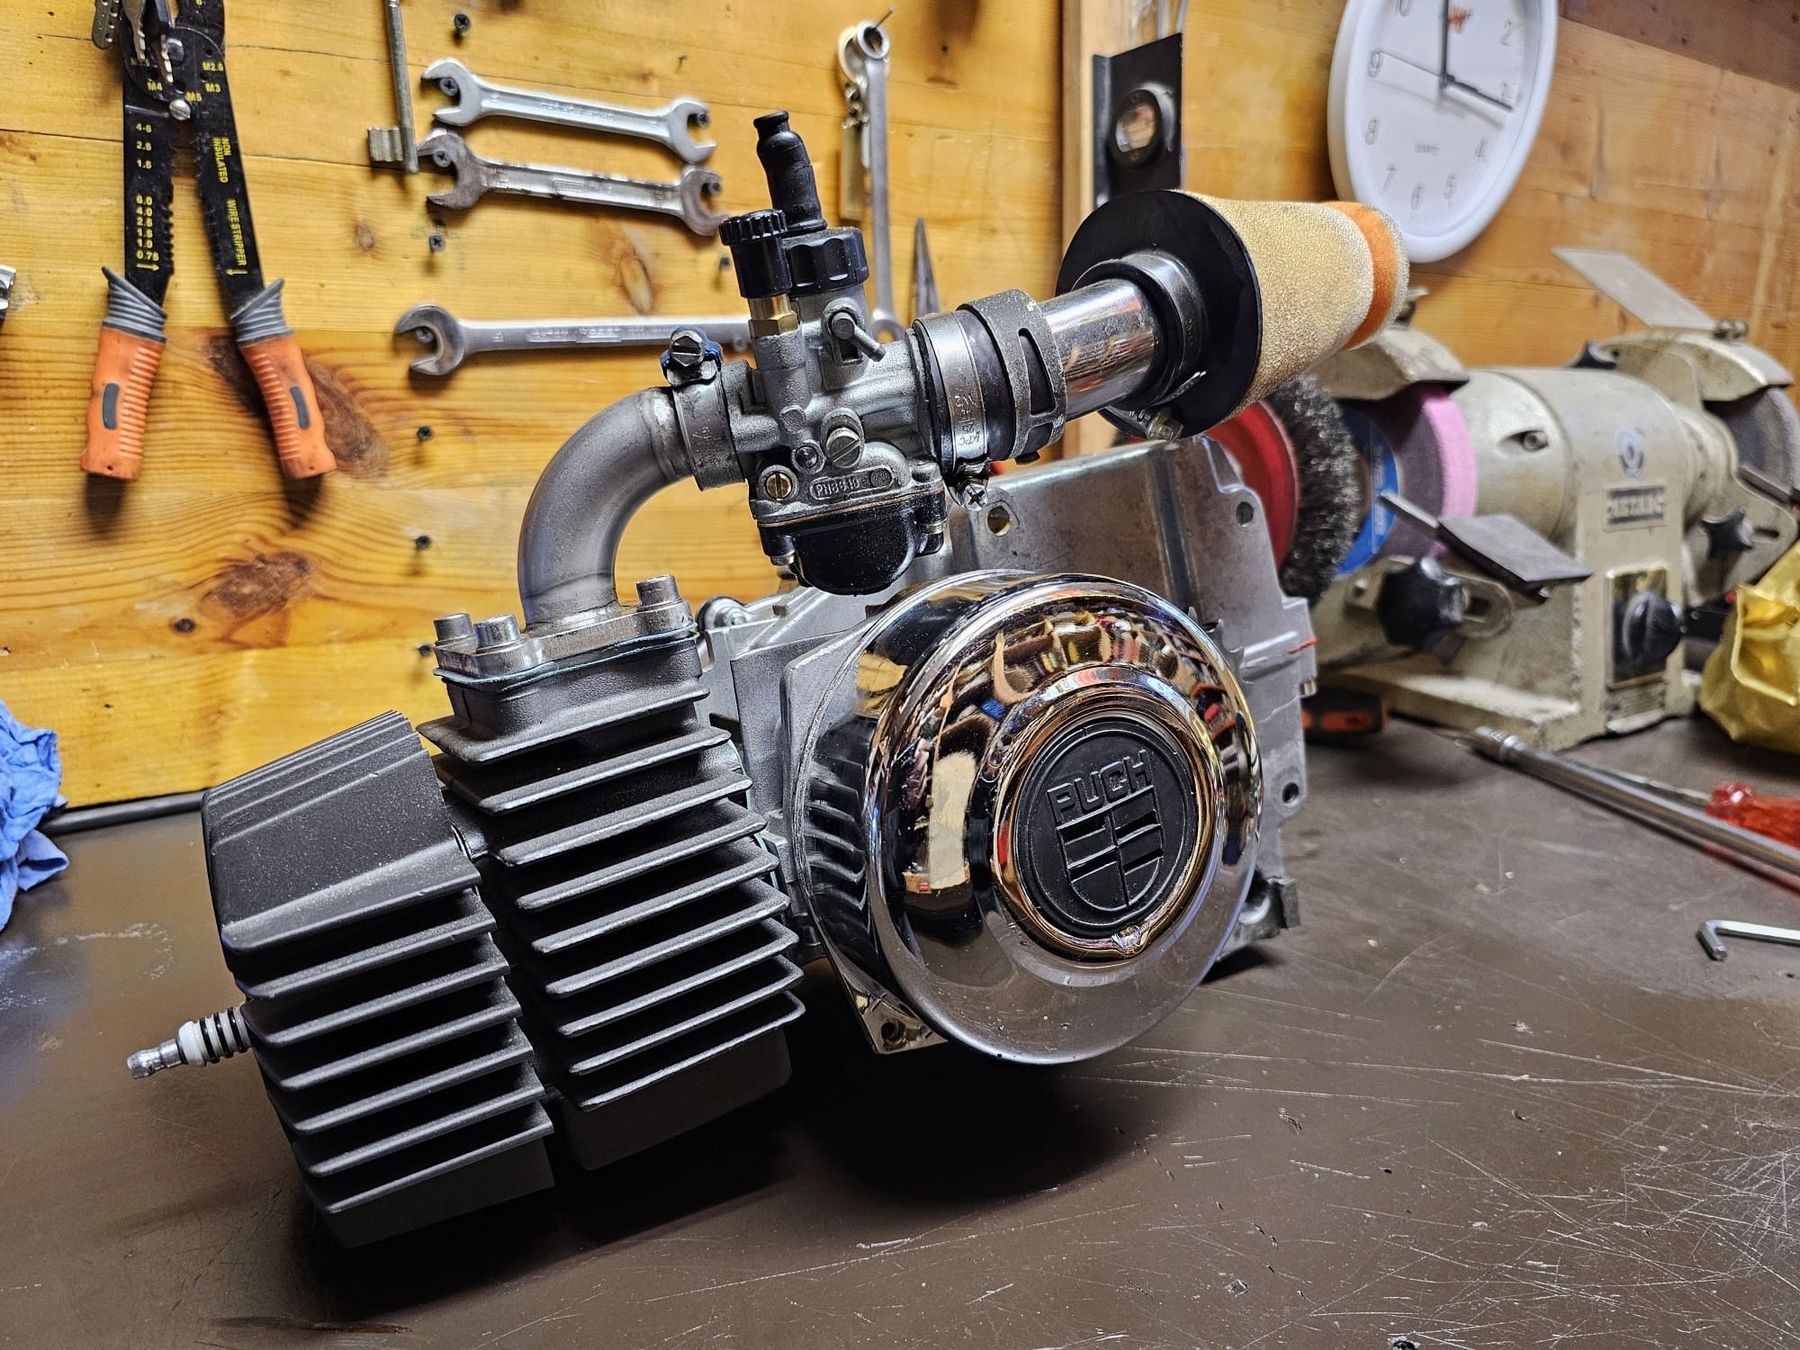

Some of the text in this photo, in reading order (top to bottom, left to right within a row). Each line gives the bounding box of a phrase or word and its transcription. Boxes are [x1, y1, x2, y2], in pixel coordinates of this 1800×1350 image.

[147, 81, 163, 91] M4
[205, 82, 221, 93] M3
[185, 91, 202, 102] M5
[221, 136, 232, 156] NON
[212, 136, 229, 183] INSULATED
[226, 197, 248, 266] WIRE STRIPPER
[1047, 749, 1153, 826] PUCH
